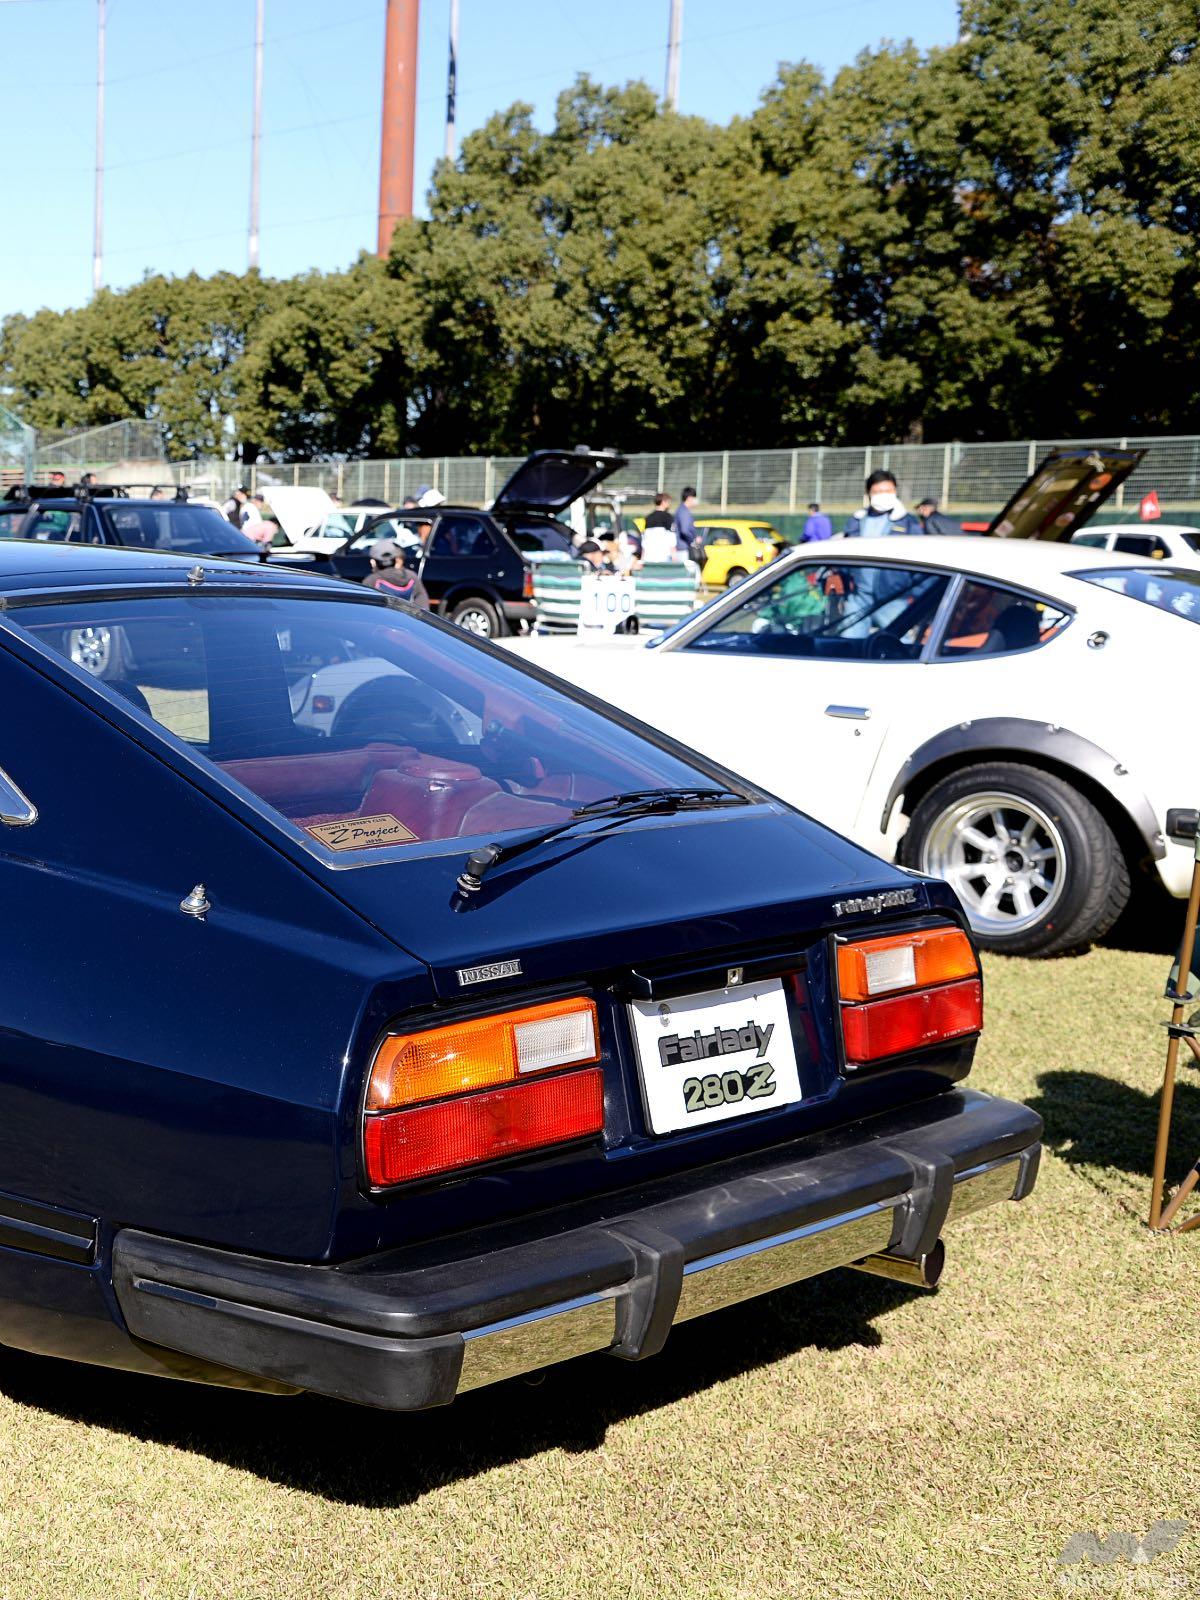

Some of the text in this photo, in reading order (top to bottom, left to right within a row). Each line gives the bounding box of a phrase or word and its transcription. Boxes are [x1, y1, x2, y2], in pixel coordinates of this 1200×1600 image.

[594, 593, 631, 613] 100
[328, 825, 400, 844] Z Project
[463, 961, 520, 982] NISSAN
[658, 1020, 775, 1067] Fairlady
